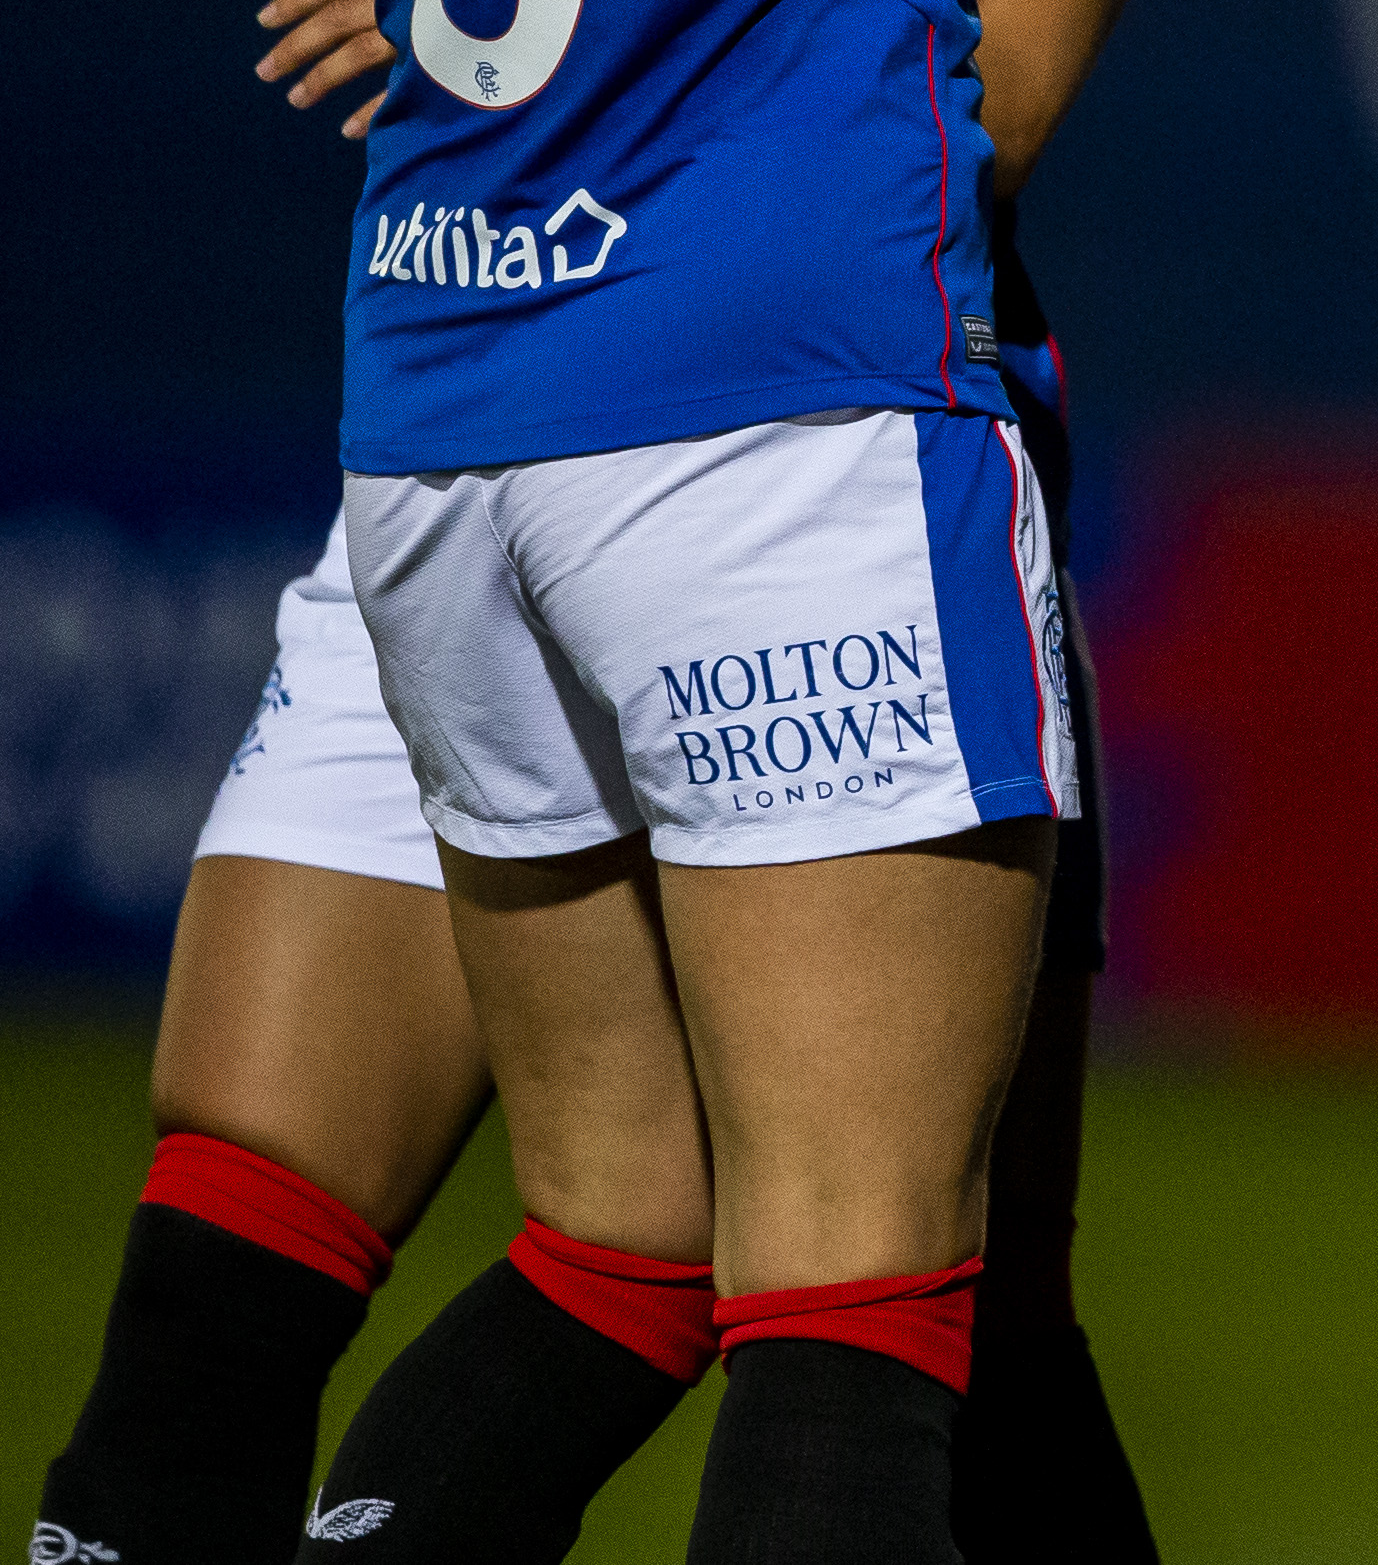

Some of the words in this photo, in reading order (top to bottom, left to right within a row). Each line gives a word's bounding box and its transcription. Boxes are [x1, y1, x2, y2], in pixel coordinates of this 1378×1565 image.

[368, 201, 543, 290] utilita
[656, 624, 926, 721] MOLTON
[673, 693, 935, 786] BROWN
[732, 766, 896, 812] LONDON
